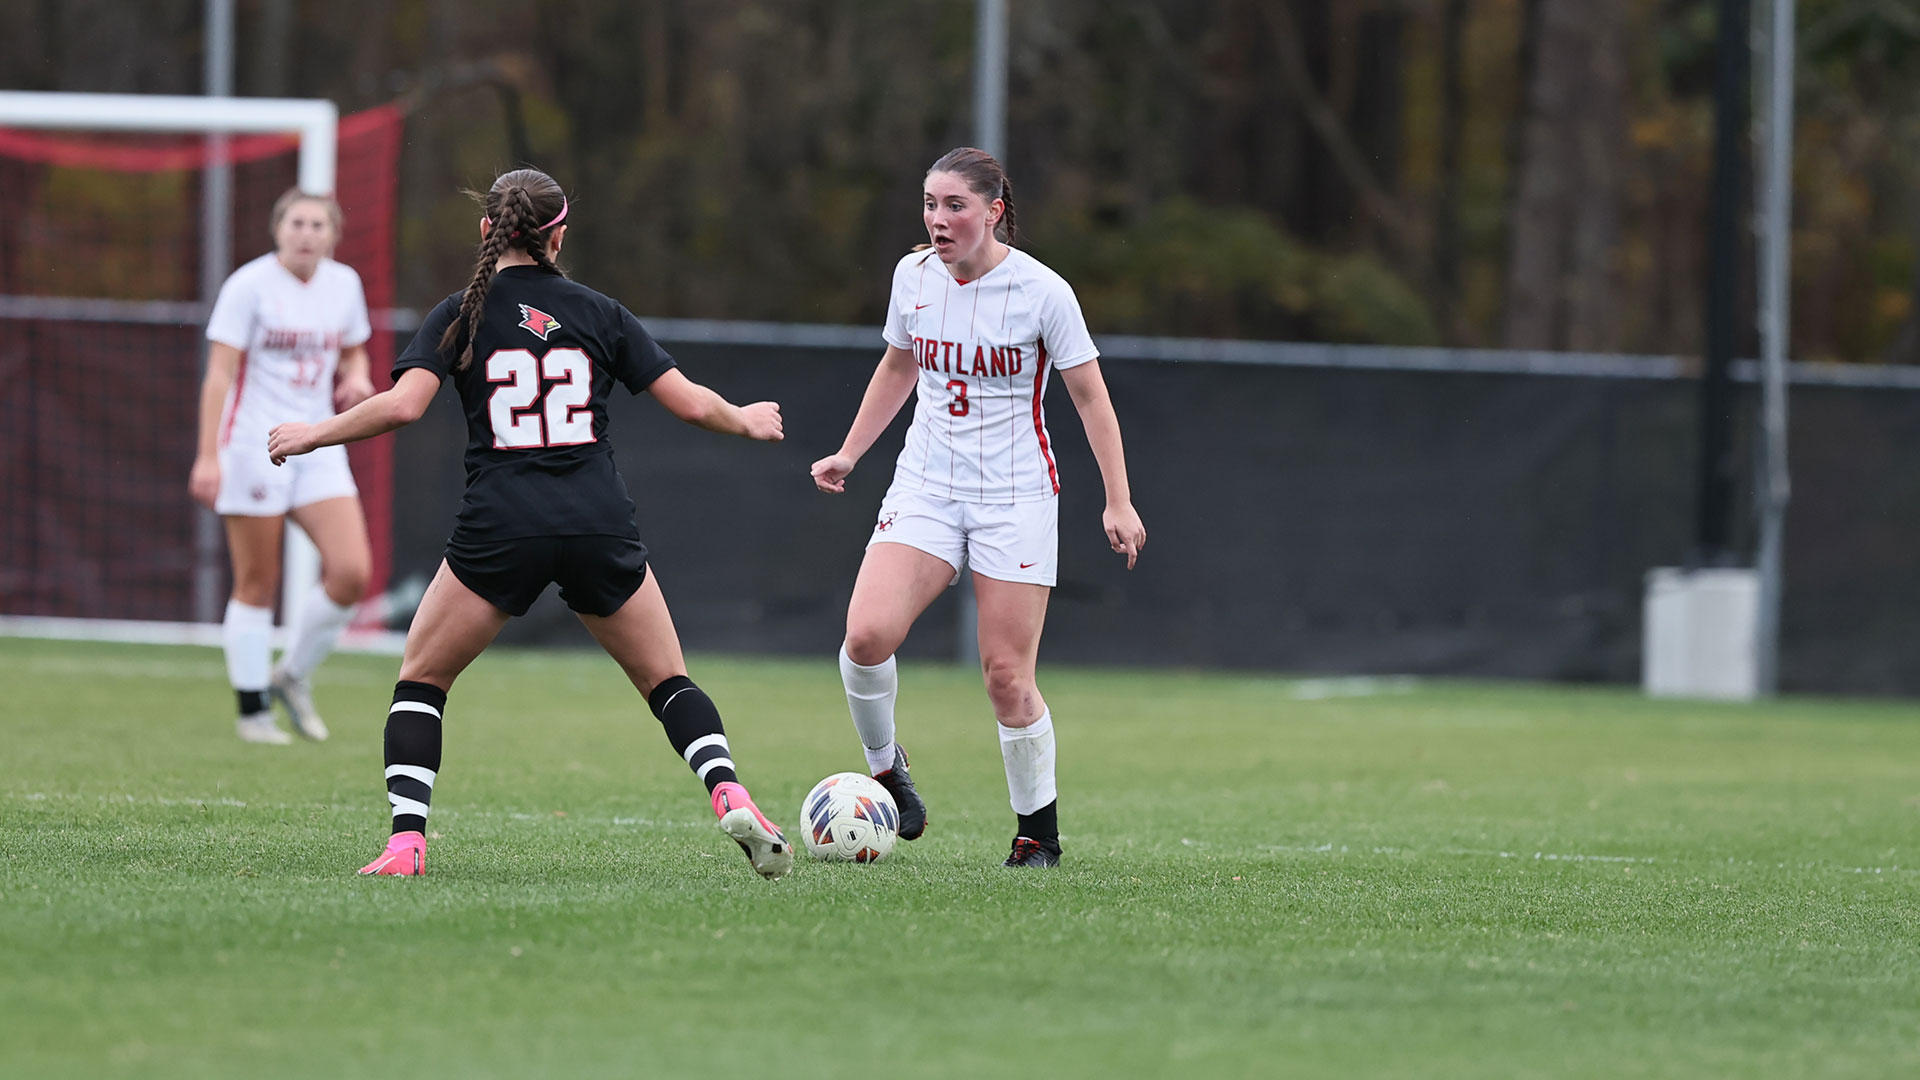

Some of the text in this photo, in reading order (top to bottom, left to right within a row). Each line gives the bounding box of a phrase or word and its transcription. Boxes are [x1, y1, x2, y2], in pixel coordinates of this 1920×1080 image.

[914, 337, 1022, 377] ORTLAND
[485, 347, 597, 450] 22
[946, 379, 969, 416] 3
